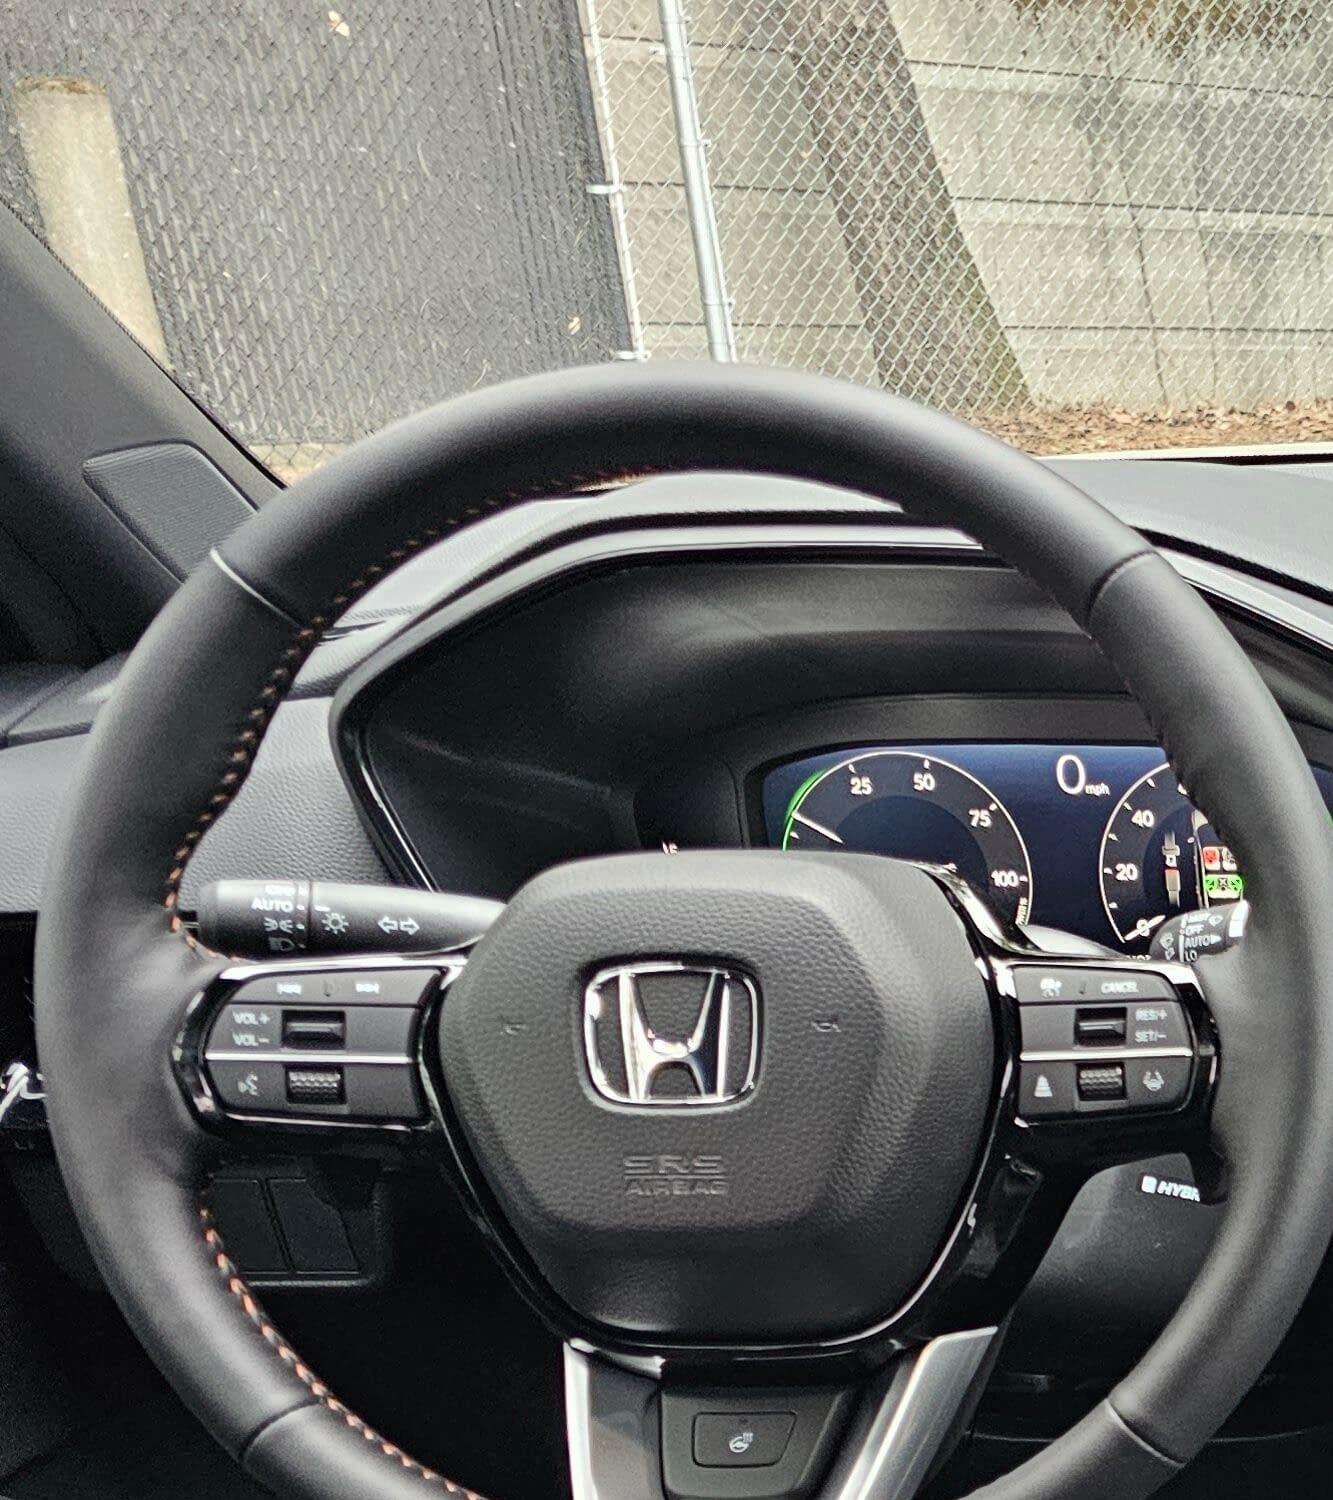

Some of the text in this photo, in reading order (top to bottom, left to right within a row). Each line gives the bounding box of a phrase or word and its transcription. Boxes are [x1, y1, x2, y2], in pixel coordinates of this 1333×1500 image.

[913, 772, 935, 791] 50
[1056, 754, 1086, 794] 0
[851, 777, 873, 795] 25
[1085, 783, 1110, 796] mph
[968, 809, 992, 827] 75
[1131, 809, 1154, 828] 40
[991, 870, 1019, 888] 100
[1115, 863, 1138, 881] 20
[252, 898, 294, 913] AUTO
[1185, 925, 1204, 937] OFF
[1185, 935, 1210, 948] AUTO
[1185, 951, 1197, 962] LO
[623, 1155, 723, 1174] SRS
[625, 1180, 728, 1196] AIRBAG
